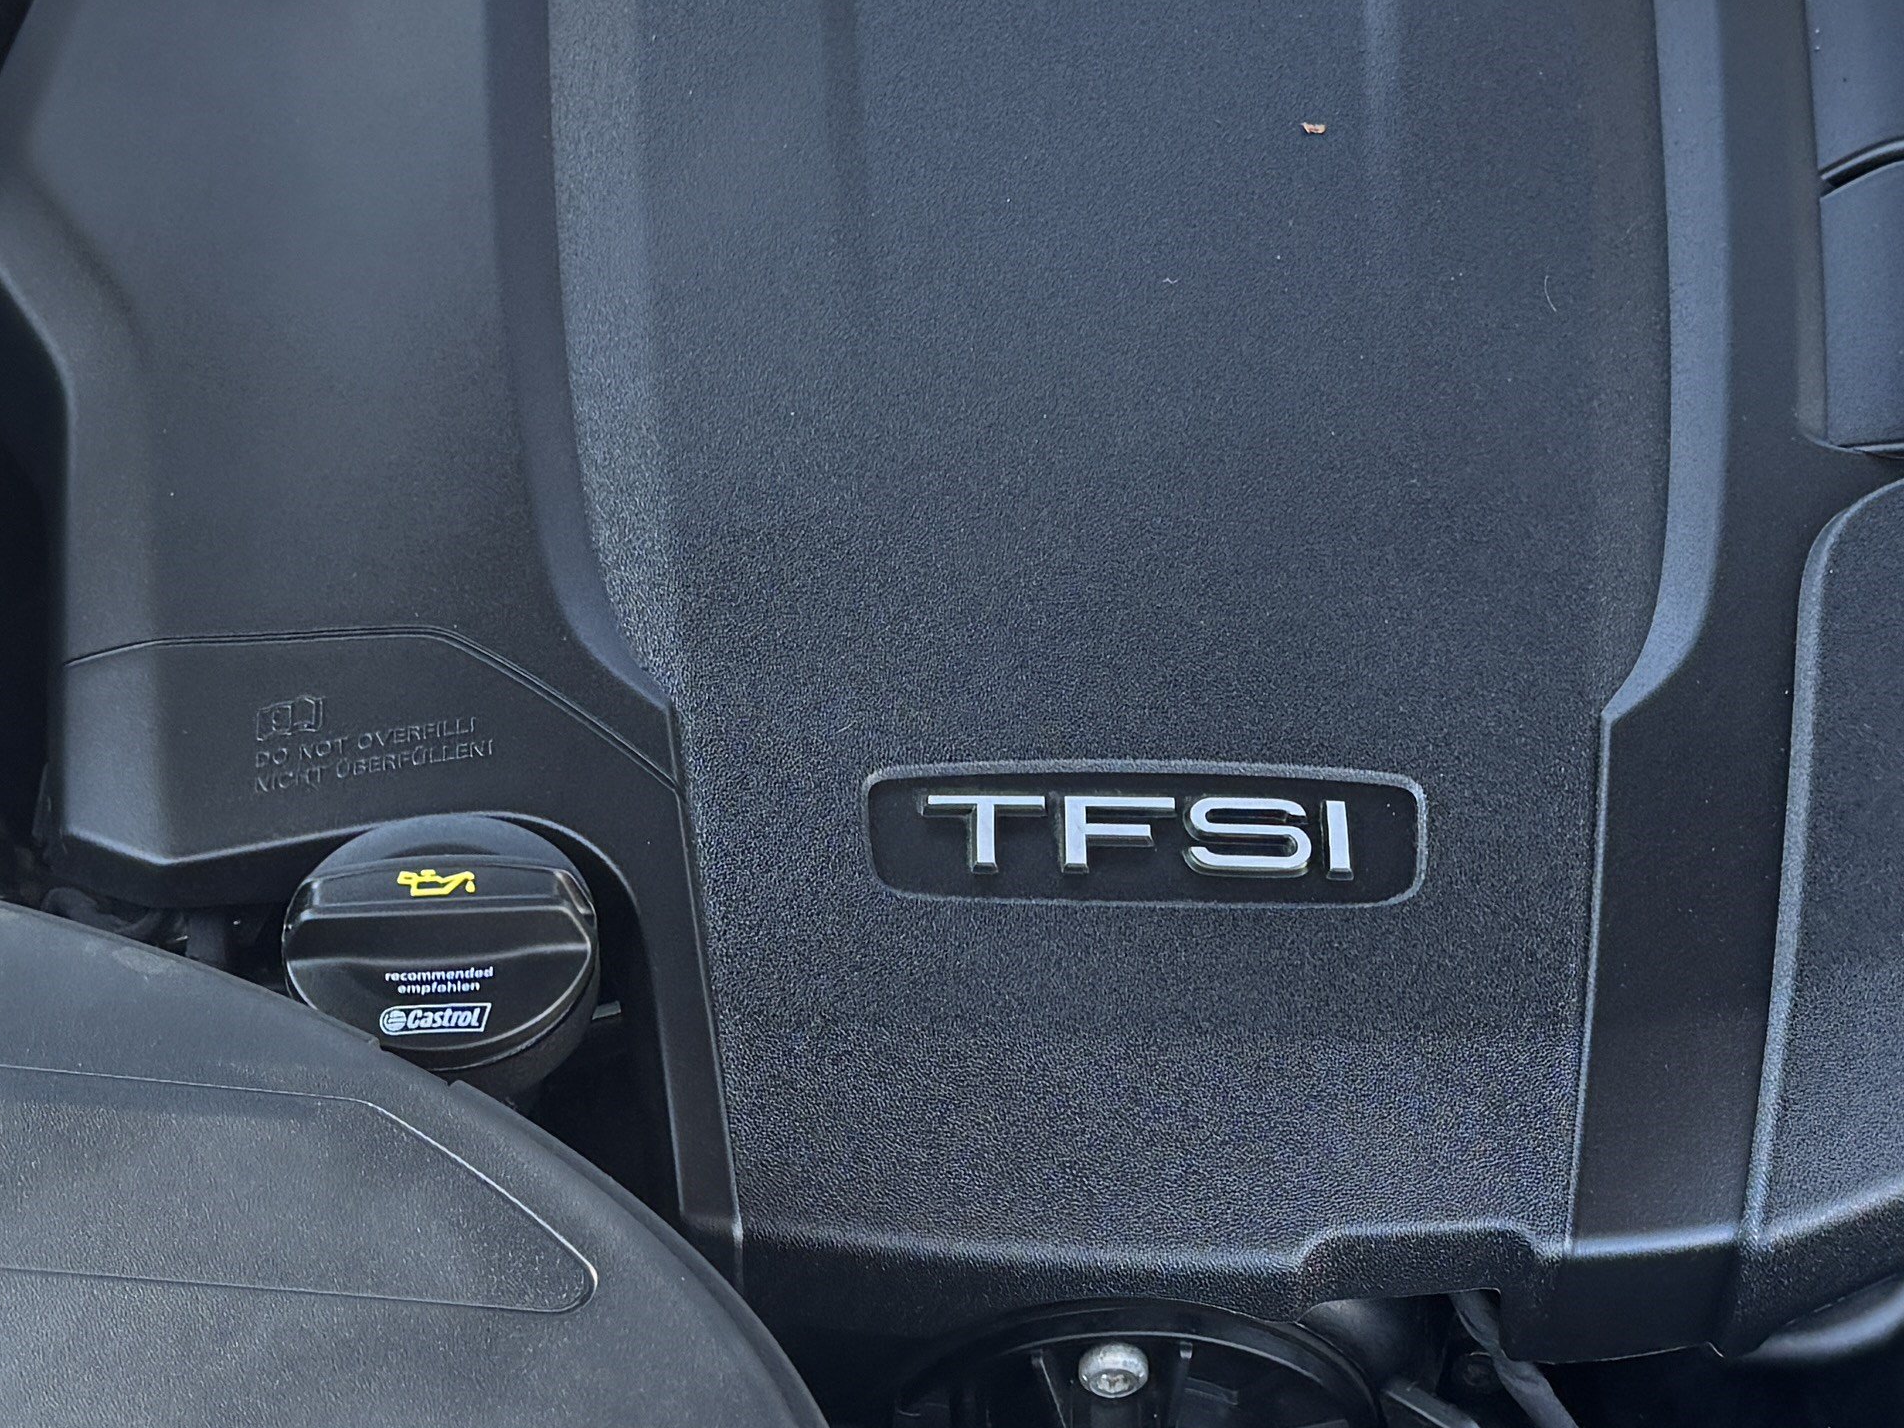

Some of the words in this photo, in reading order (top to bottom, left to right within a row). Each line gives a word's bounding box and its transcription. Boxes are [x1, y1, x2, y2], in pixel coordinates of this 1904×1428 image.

[255, 747, 288, 768] DO
[299, 736, 349, 759] NOT
[254, 765, 324, 793] NICHT
[922, 794, 1354, 880] TFSI
[385, 966, 494, 982] recommended
[397, 981, 481, 996] empfohlen
[406, 1007, 481, 1029] Castrol
